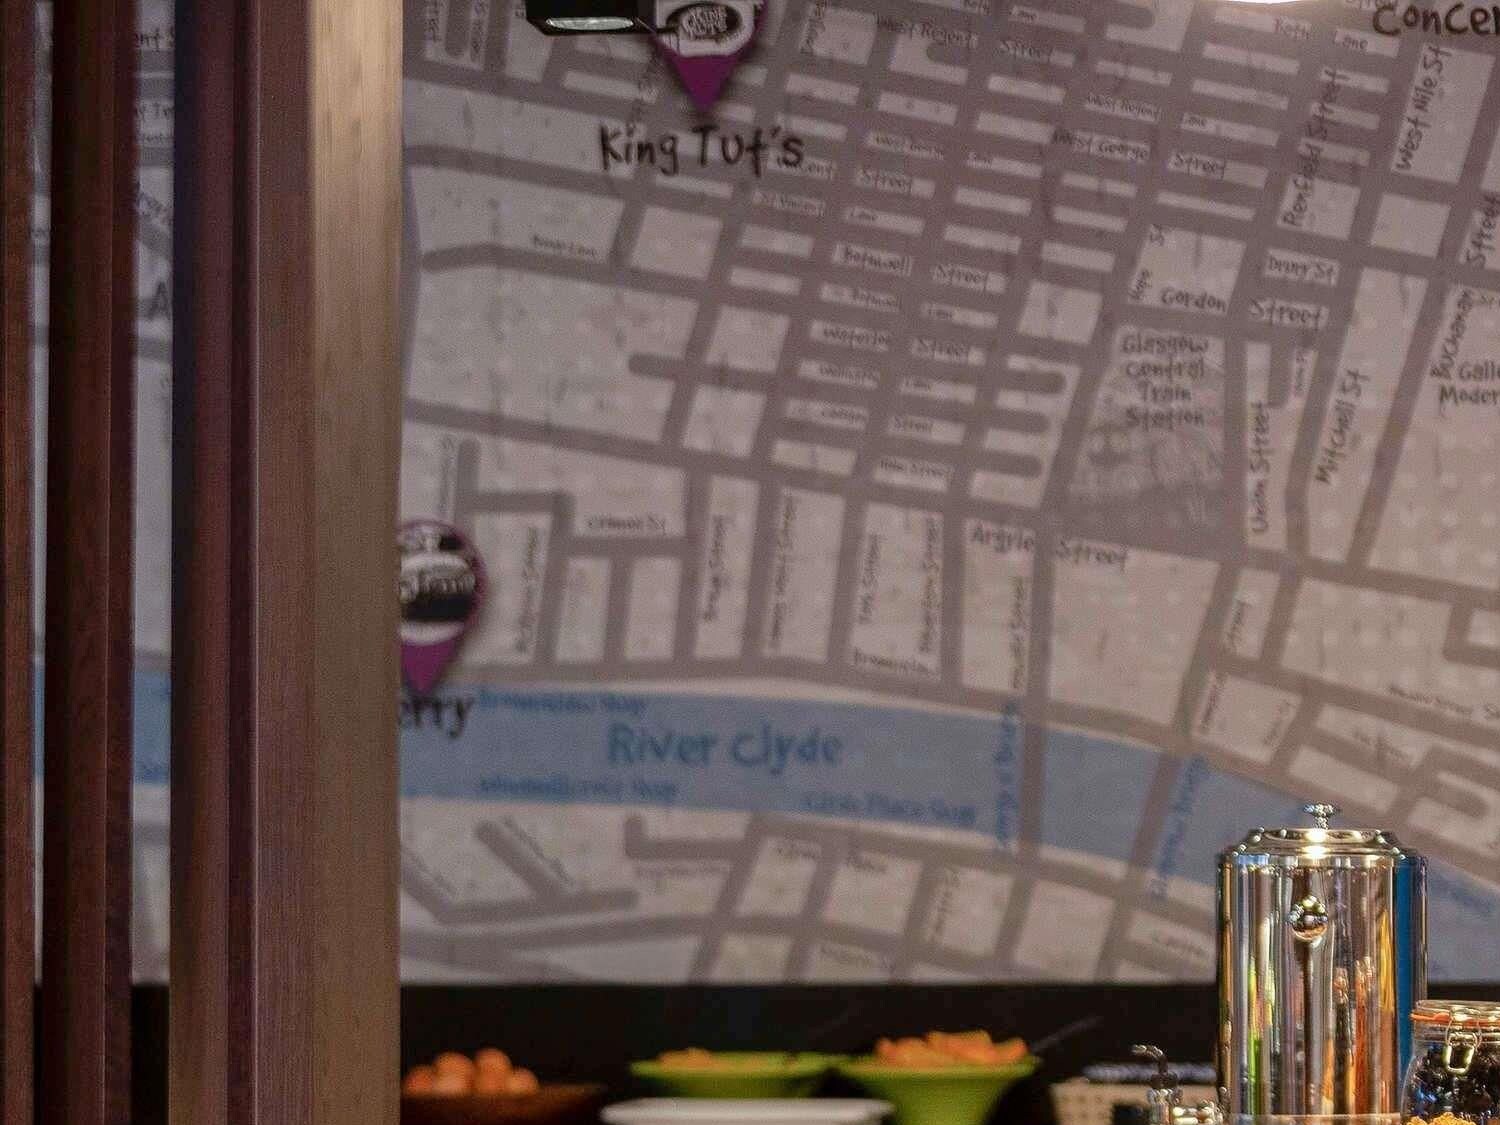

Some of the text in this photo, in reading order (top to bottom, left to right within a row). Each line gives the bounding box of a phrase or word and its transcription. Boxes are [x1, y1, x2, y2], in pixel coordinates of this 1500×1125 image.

[1396, 45, 1453, 173] West Nile St
[599, 124, 806, 179] King Tut's
[1161, 285, 1324, 333] Gordon Street
[607, 722, 714, 766] River
